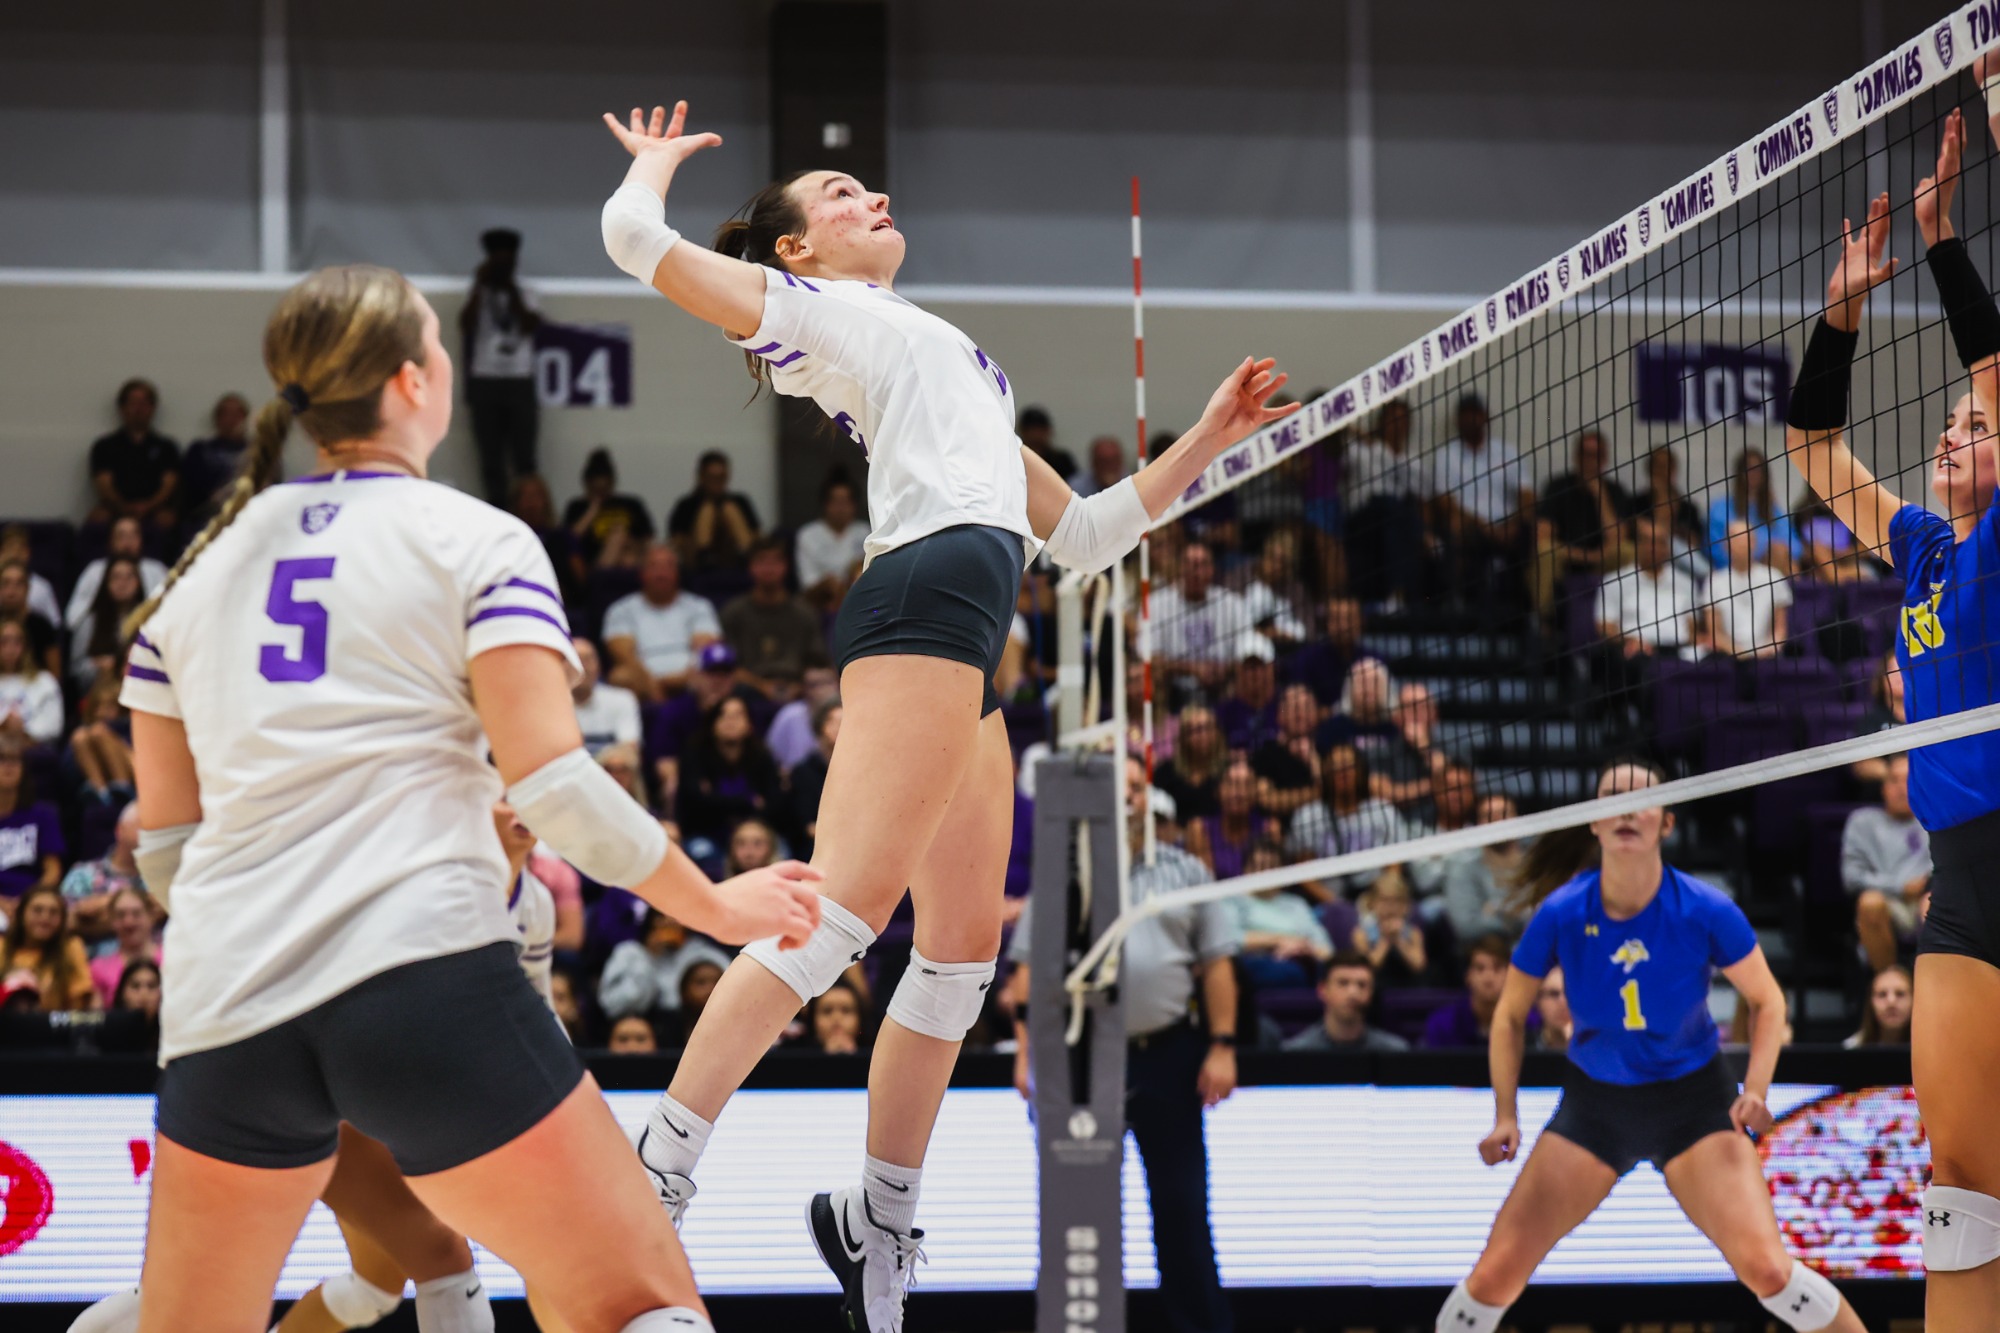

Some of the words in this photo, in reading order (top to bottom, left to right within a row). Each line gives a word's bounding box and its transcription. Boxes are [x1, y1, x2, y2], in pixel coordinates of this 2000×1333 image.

[1753, 112, 1814, 181] TOMMIES
[1854, 46, 1923, 119] TOMMIES
[534, 347, 613, 407] 04
[1679, 365, 1777, 426] 105
[259, 556, 336, 682] 5
[1619, 978, 1647, 1031] 1
